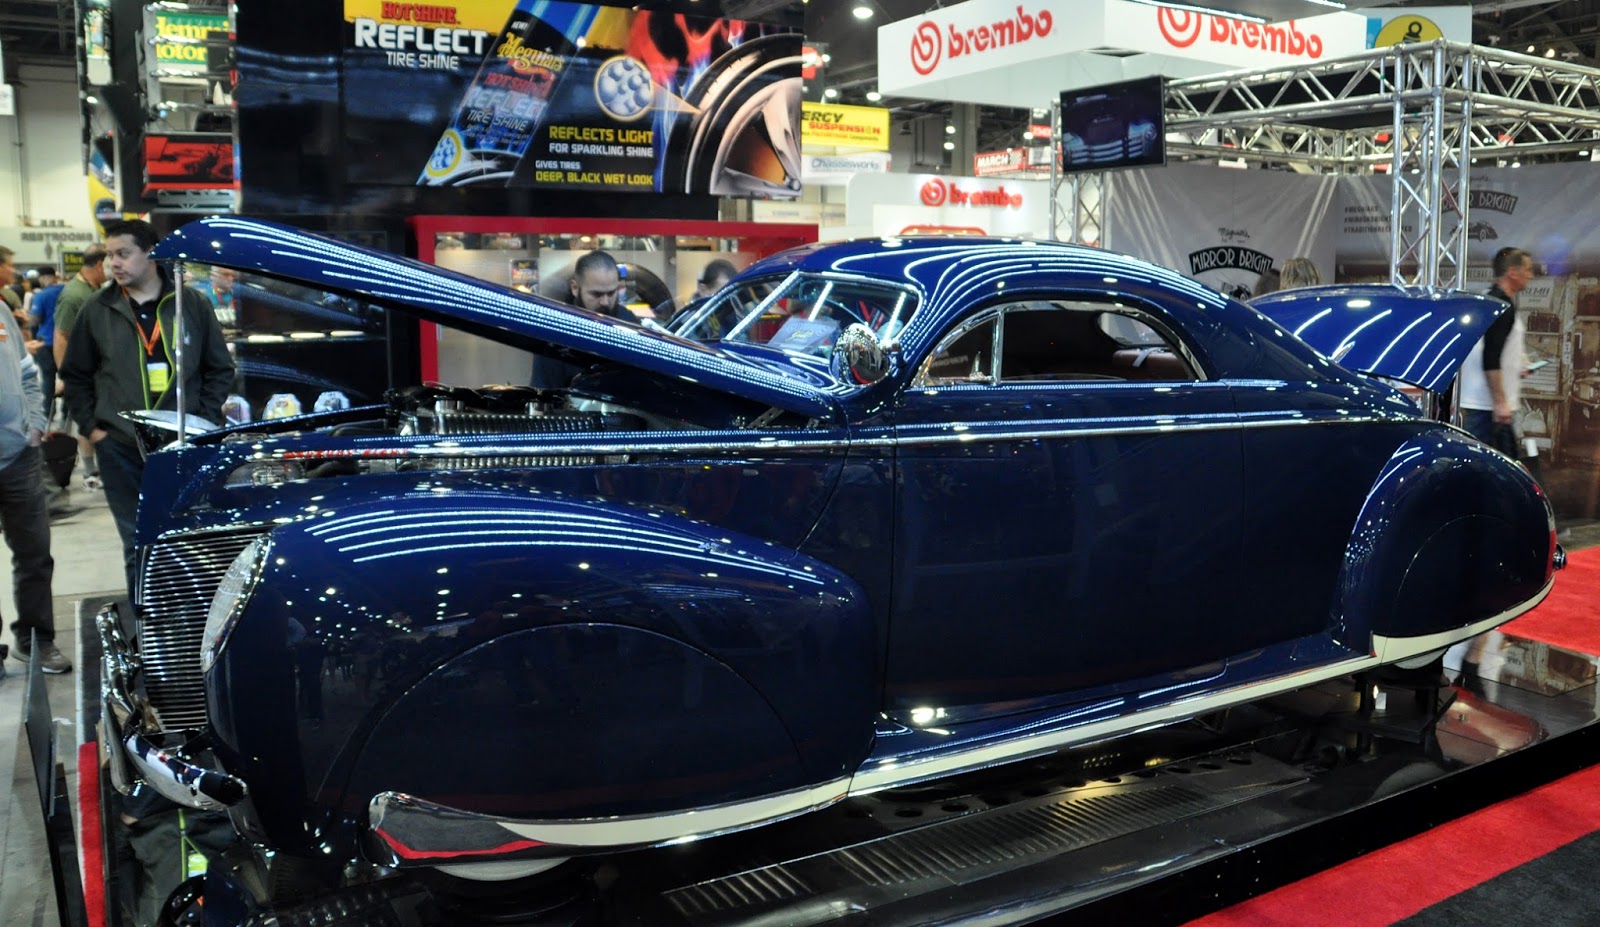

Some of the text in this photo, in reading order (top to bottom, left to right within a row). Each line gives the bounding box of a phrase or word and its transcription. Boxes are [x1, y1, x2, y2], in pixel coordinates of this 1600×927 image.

[355, 18, 488, 55] REFLECT
[948, 5, 1053, 58] brembo
[1210, 15, 1323, 59] brembo
[156, 44, 207, 61] otor
[386, 51, 459, 70] TIRE SHINE
[467, 109, 529, 131] TIRE SHINE
[549, 125, 615, 141] REFLECTS
[618, 129, 654, 144] LIGHT
[549, 142, 654, 158] FOR SPARKLING SHINE
[535, 160, 581, 170] GIVES TIRES
[535, 171, 653, 186] DEEP, BLACK WET LOOK
[949, 183, 1023, 207] brembo
[1479, 192, 1516, 215] BRIGHT
[1192, 248, 1272, 274] MIRROR BRIGHT
